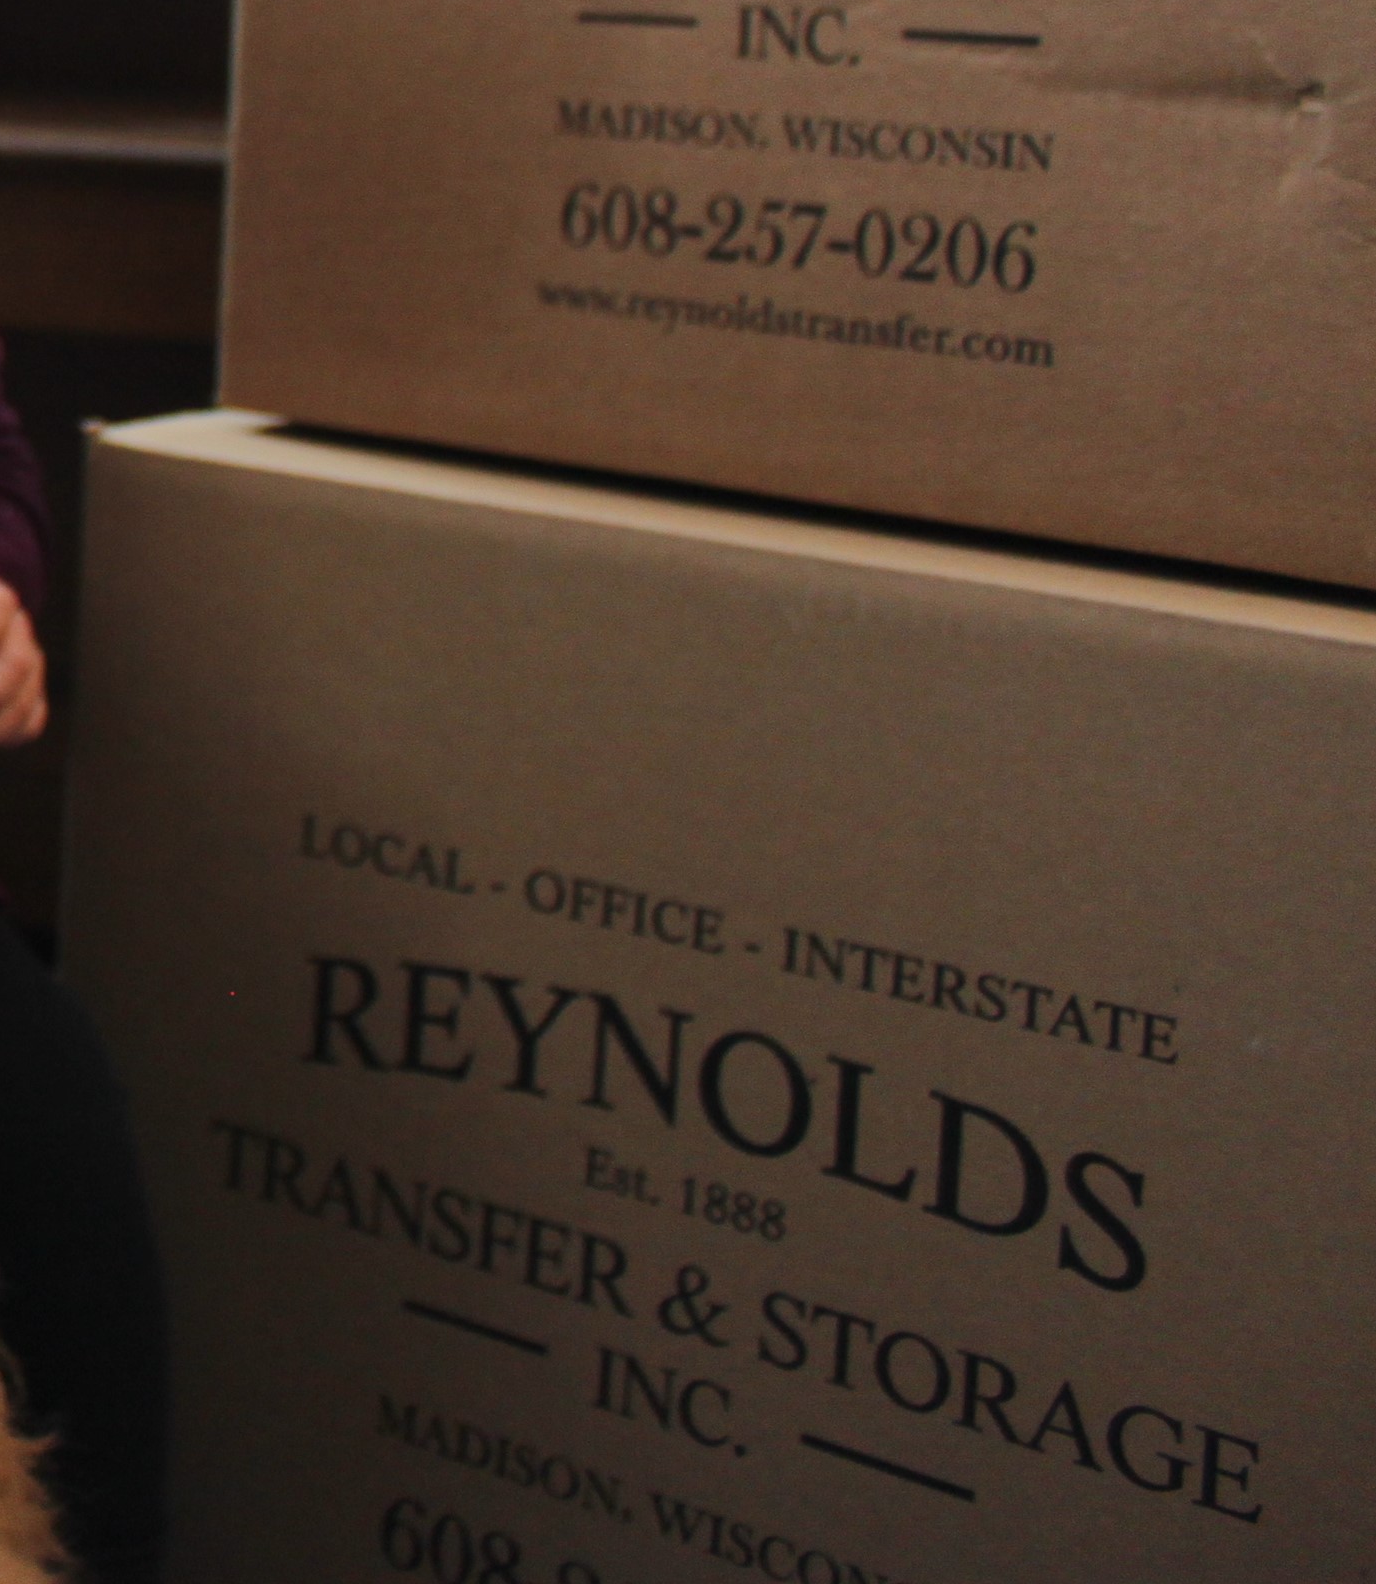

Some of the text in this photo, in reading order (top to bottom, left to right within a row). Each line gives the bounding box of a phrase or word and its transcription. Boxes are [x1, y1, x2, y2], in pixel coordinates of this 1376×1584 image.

[736, 6, 861, 67] INC.
[782, 115, 1055, 173] WISCONSIN
[559, 183, 1038, 294] 608-257-0206
[535, 276, 1055, 368] www.reynoldstransfer.com
[299, 814, 475, 895] LOCAL
[524, 868, 725, 955] OFFICE
[782, 926, 1181, 1066] INTERSTATE
[303, 955, 1147, 1293] REYNOLDS
[584, 1145, 787, 1242] Est. 1888
[210, 1119, 1264, 1525] TRANSFER & STORAGE
[591, 1346, 748, 1459] INC.
